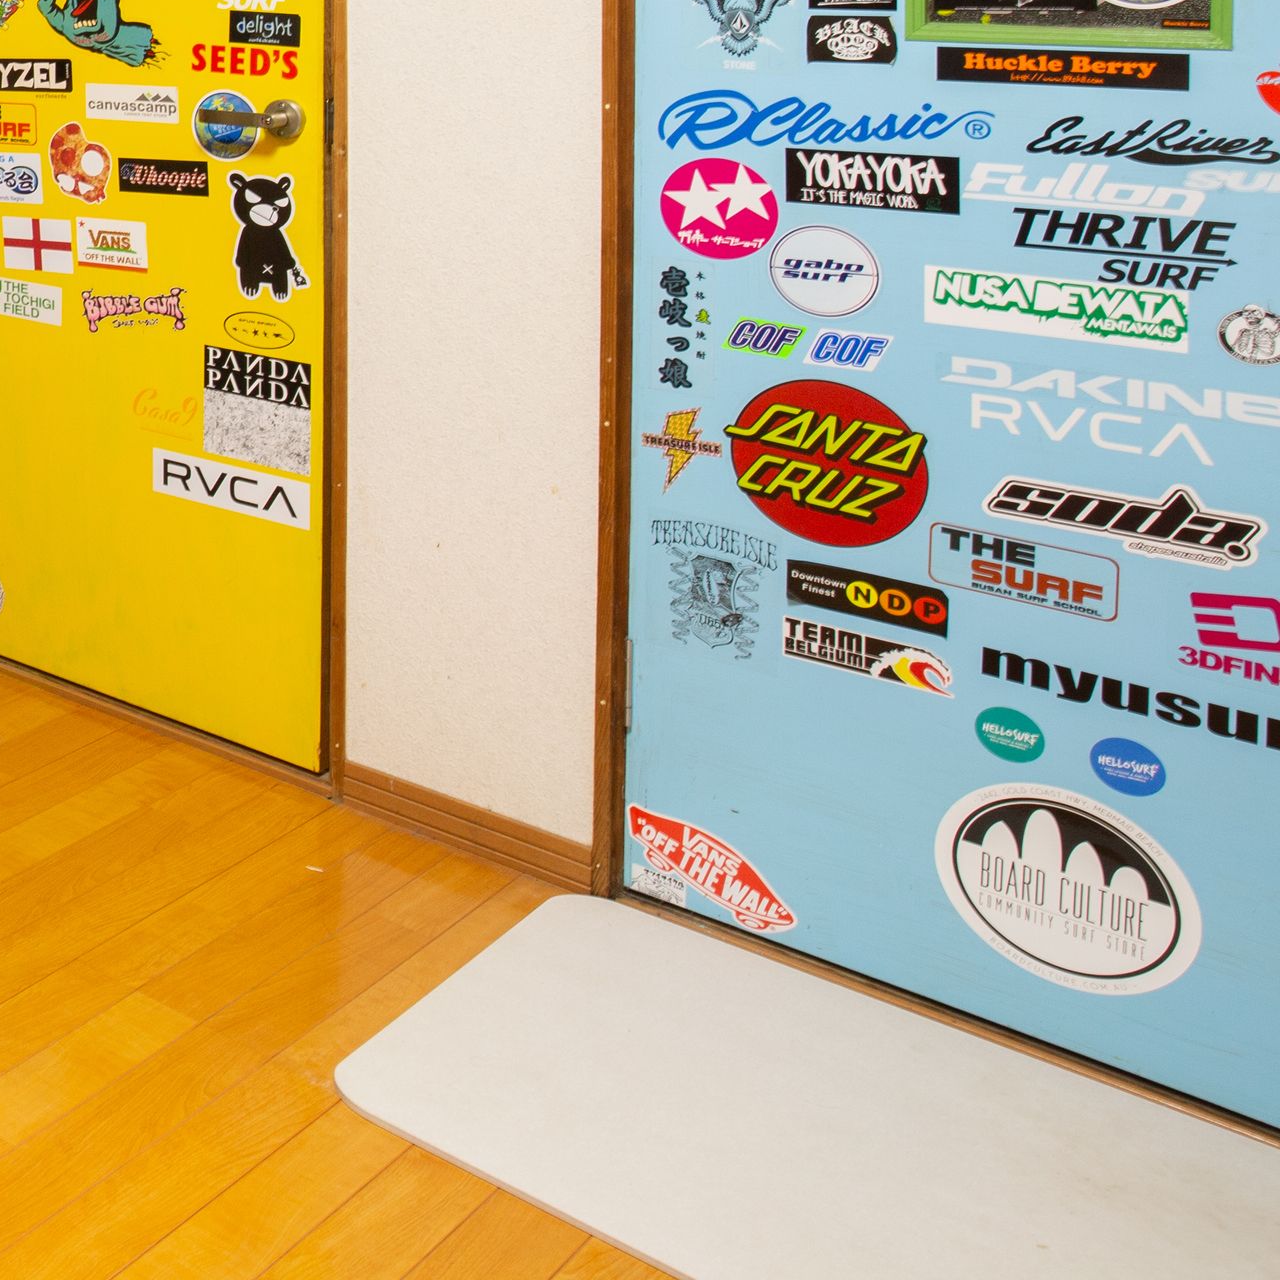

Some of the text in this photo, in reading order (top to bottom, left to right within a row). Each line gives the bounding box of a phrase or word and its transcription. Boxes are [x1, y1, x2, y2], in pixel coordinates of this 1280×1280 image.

[236, 14, 292, 39] delight
[191, 43, 299, 80] SEED'S
[963, 52, 1063, 72] Huckle
[1071, 55, 1158, 79] Berry
[88, 98, 177, 116] canvascamp
[827, 189, 848, 205] THE
[850, 191, 884, 207] MAGIC
[88, 229, 131, 250] VANS
[1013, 208, 1237, 265] THRIVE
[100, 254, 116, 263] THE
[783, 258, 864, 273] gabo
[1097, 258, 1219, 291] SURF
[4, 281, 29, 294] THE
[783, 270, 856, 283] surf
[4, 303, 40, 319] FIELD
[5, 293, 55, 310] TOCHIGI
[143, 296, 183, 320] GUM
[934, 270, 1188, 329] NUSA DEWATA
[659, 265, 692, 388] 壱岐っ娘
[728, 320, 888, 368] COF COF
[1085, 318, 1178, 342] MENTAWAIS
[940, 356, 1280, 428] DAKINE
[643, 434, 721, 455] TREASURE ISLE
[724, 404, 927, 477] SANTA
[970, 393, 1214, 467] RVCA
[162, 458, 298, 519] RVCA
[737, 454, 904, 524] CRUZ
[651, 520, 778, 571] TREASURE ISLE
[940, 526, 1036, 568] THE
[791, 569, 847, 590] Downtown
[801, 583, 836, 599] Finest
[970, 559, 1104, 604] SURF
[971, 582, 1102, 618] BUSAN SURF SCHOOL
[785, 617, 863, 652] TEAM
[682, 826, 743, 877] VANS
[679, 847, 724, 893] THE
[980, 851, 1150, 942] BOARD CULTURE
[978, 891, 1146, 962] COMMUNITY SURF STORE
